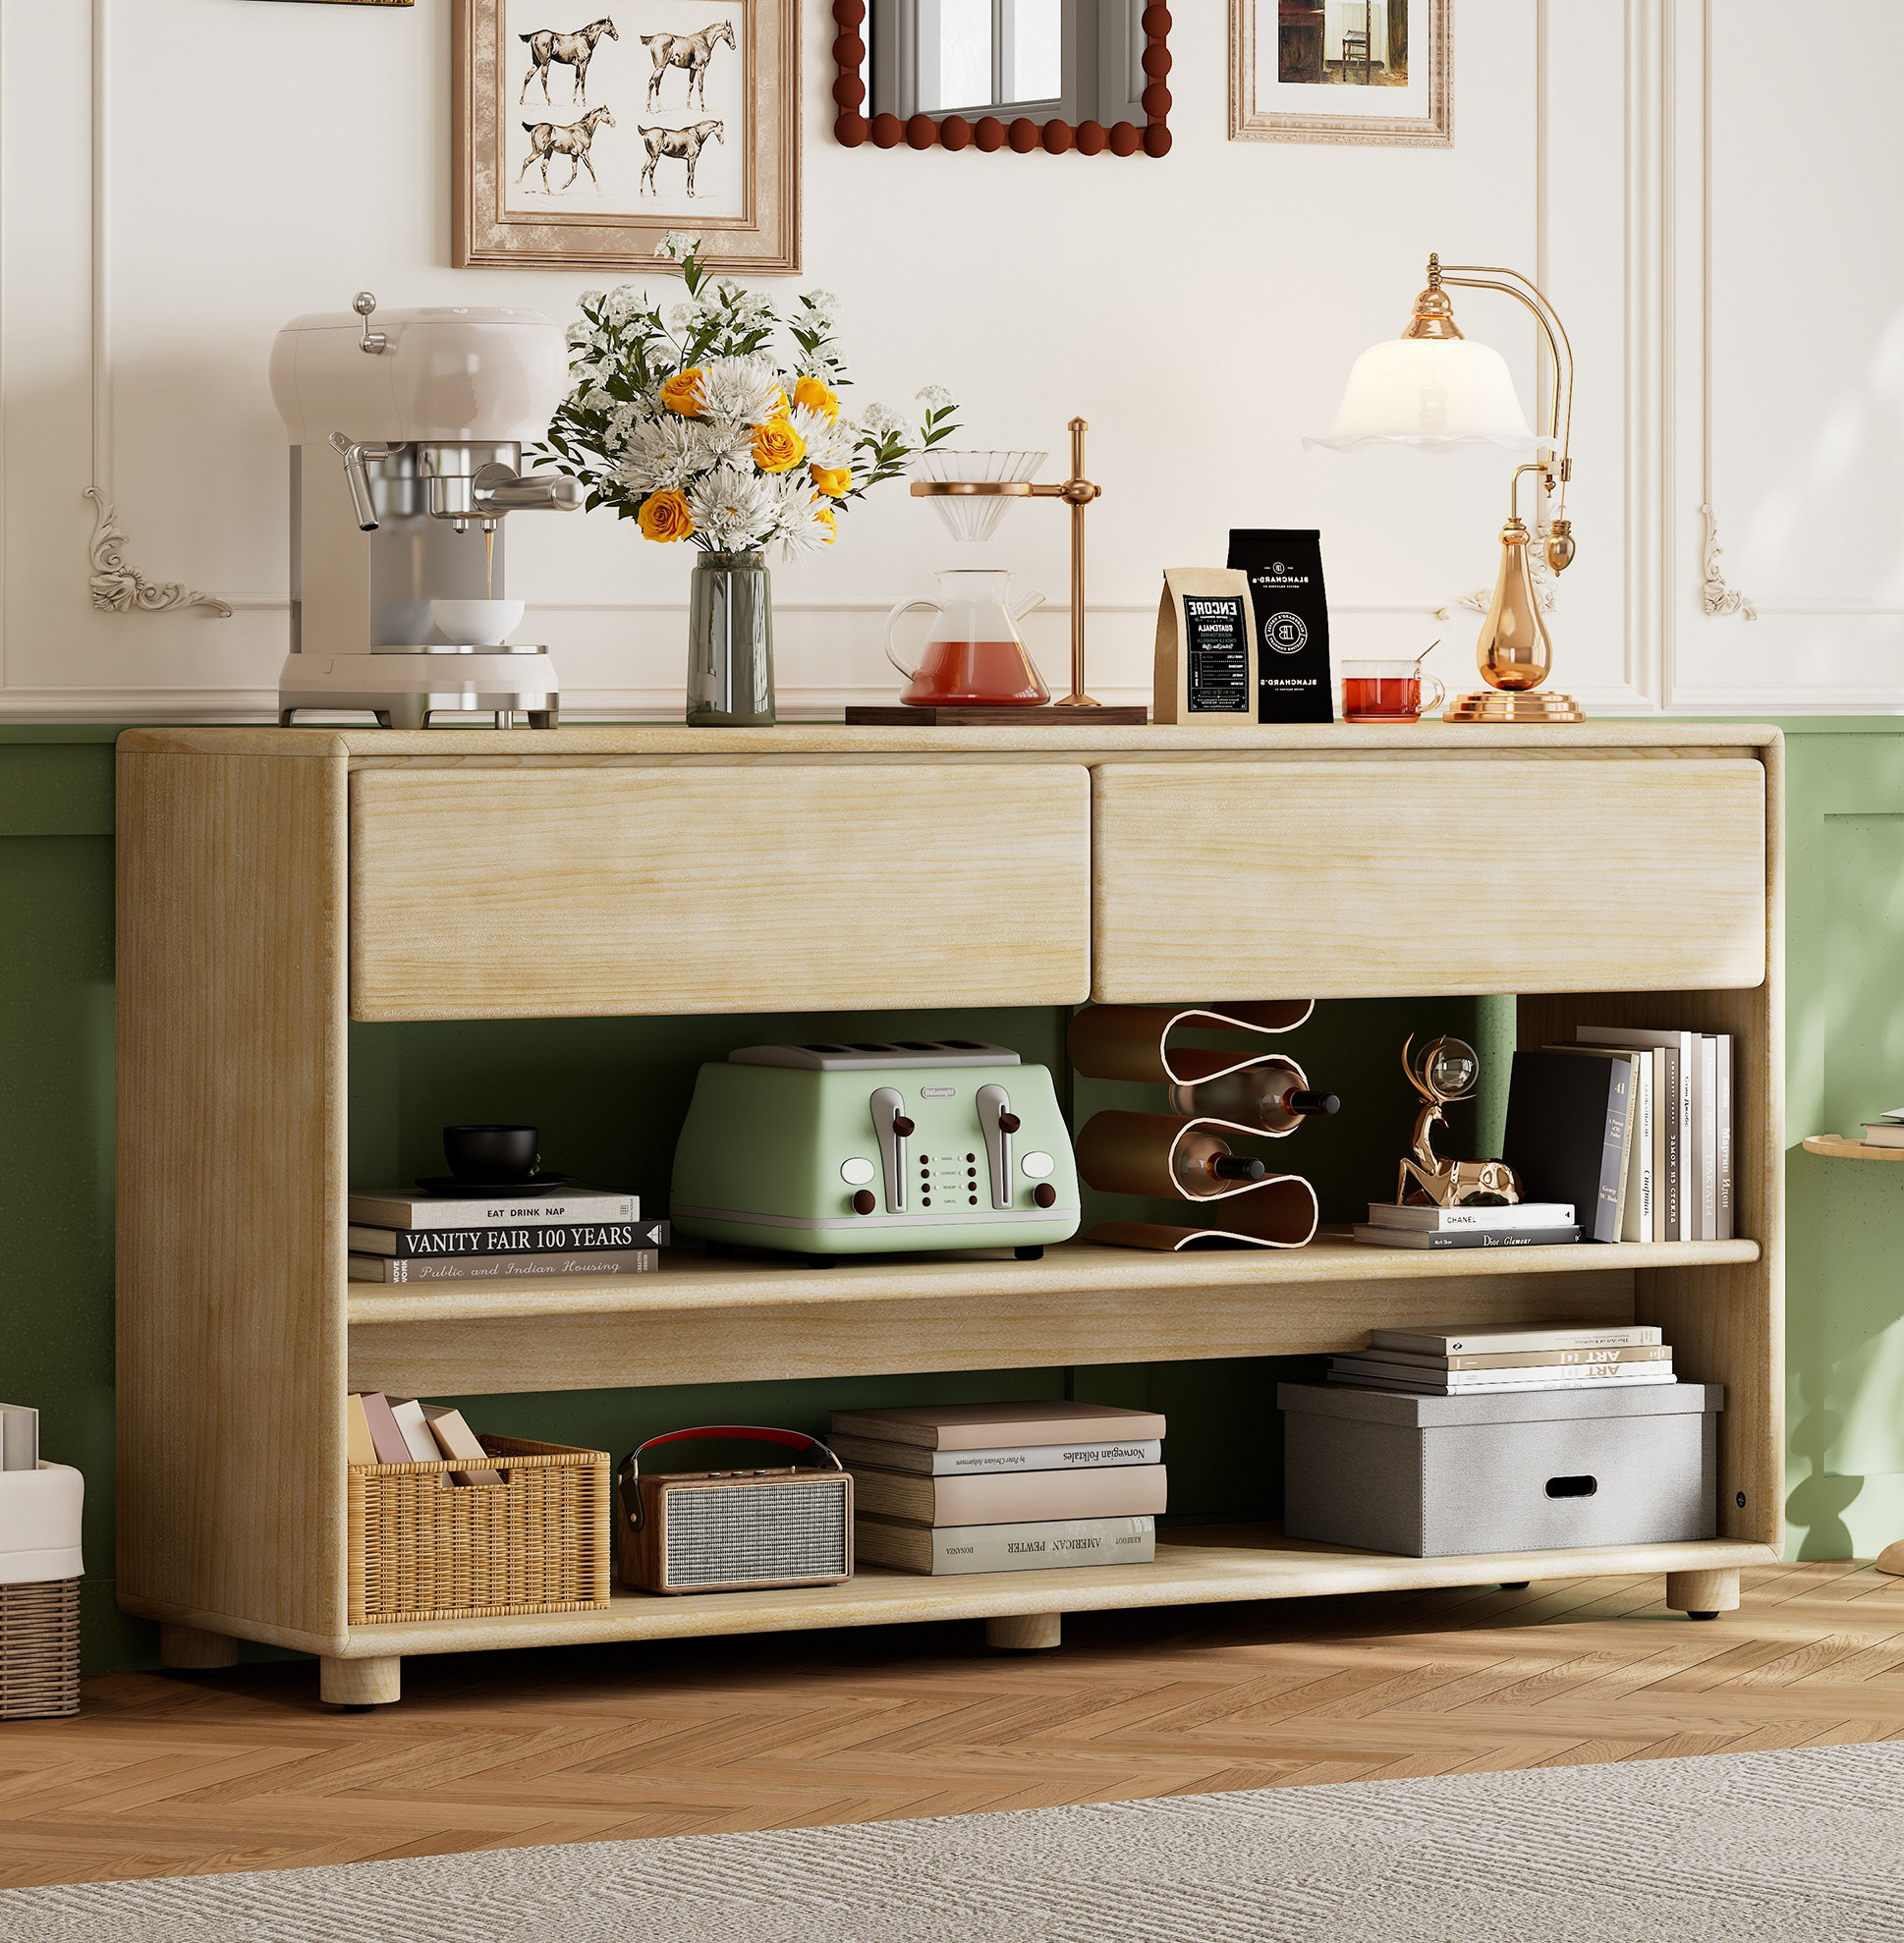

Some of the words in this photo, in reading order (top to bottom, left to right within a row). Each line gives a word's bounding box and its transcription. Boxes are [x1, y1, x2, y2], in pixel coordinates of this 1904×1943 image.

[1614, 1082, 1625, 1095] 41
[1721, 1128, 1730, 1173] Мартин
[1670, 1171, 1676, 1184] из
[1721, 1178, 1730, 1208] Иден
[487, 1209, 504, 1218] EAT
[510, 1208, 540, 1217] DRINK
[545, 1207, 565, 1216] NAP
[1446, 1215, 1477, 1224] CHANEL
[405, 1230, 482, 1254] VANITY
[486, 1229, 531, 1250] FAIR
[536, 1228, 566, 1249] 100
[572, 1226, 633, 1248] YEARS
[1483, 1235, 1500, 1247] Dior
[1503, 1236, 1533, 1246] Glamour
[420, 1265, 465, 1278] Public
[471, 1263, 500, 1276] and
[504, 1262, 554, 1275] Indian
[561, 1260, 621, 1274] Housing
[1585, 1351, 1621, 1362] ART
[1586, 1365, 1620, 1376] ART
[1019, 1455, 1026, 1464] by
[1063, 1449, 1099, 1462] Folktales
[1101, 1447, 1146, 1460] Norwegian
[1007, 1540, 1046, 1554] PEWTER
[1052, 1537, 1101, 1551] AMERICAN
[1115, 1536, 1142, 1545] KERFOOT
[946, 1546, 974, 1555] DONANZA
